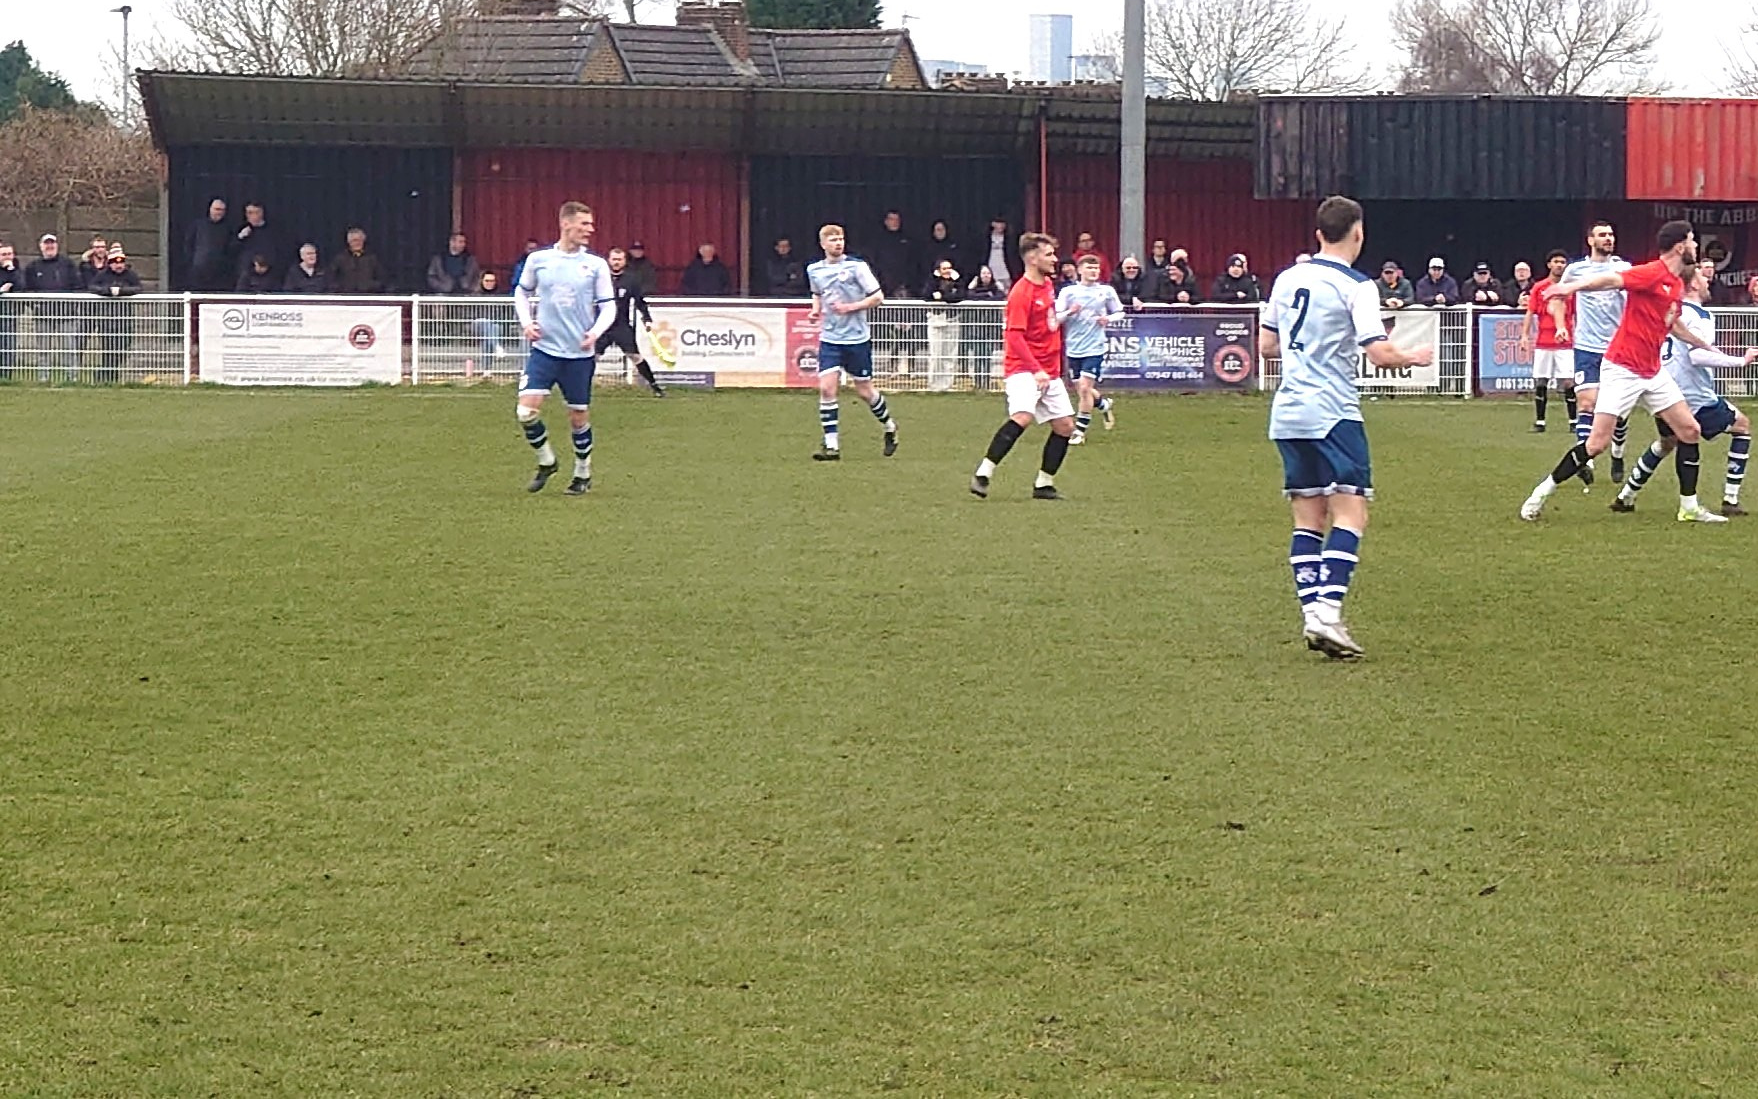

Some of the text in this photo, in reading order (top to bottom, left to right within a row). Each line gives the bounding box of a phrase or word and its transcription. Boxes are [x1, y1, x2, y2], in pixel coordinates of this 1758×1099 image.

[1654, 204, 1678, 219] UP
[1682, 208, 1714, 223] THE
[251, 312, 303, 321] KENROSS
[1288, 288, 1310, 352] 2
[680, 329, 756, 349] Cheslyn
[1144, 336, 1205, 347] VEHICLE
[1146, 347, 1205, 357] GRAPHICS
[1495, 378, 1516, 390] 0161
